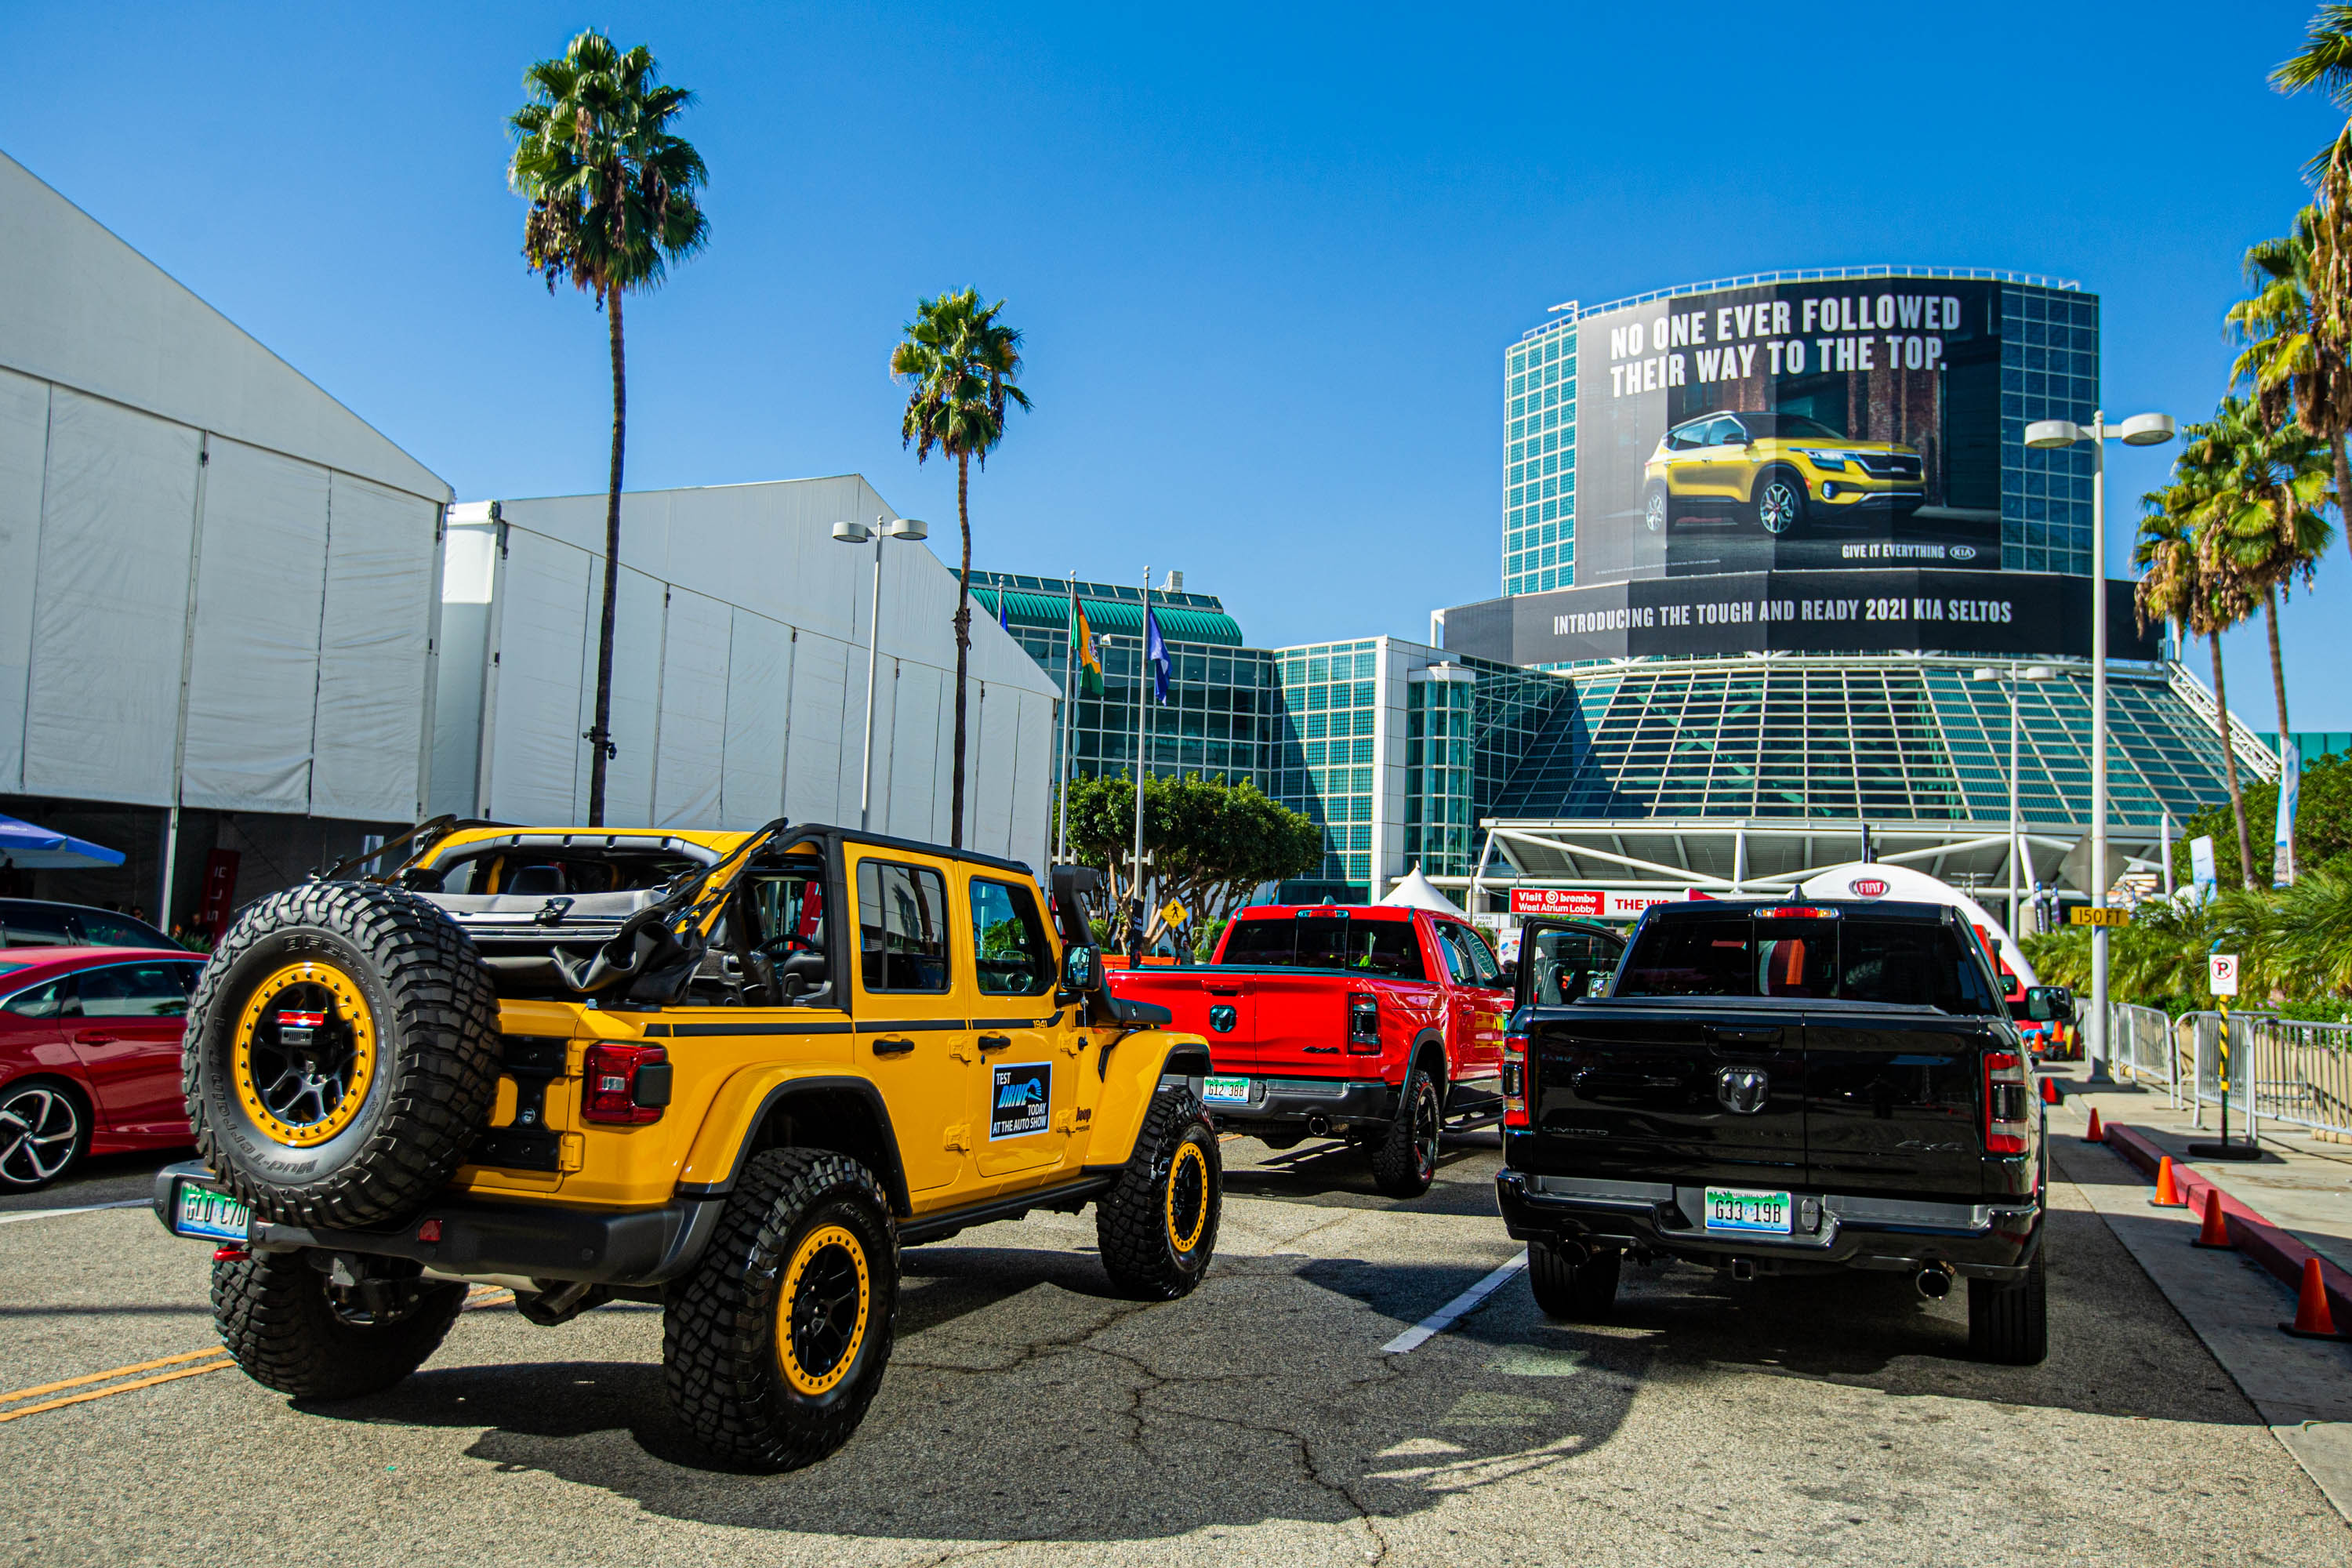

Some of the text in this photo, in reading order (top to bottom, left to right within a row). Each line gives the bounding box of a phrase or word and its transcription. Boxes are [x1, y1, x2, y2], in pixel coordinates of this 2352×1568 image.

[1610, 294, 1961, 361] NO ONE EVER FOLLOWED
[1610, 335, 1947, 398] THEIR WAY TO THE TOP.
[1842, 543, 1945, 558] GIVE IT EVERYTHING
[1952, 546, 1973, 558] KIA
[1553, 598, 2012, 635] INTRODUCING THE TOUGH AND READY 2021 KIA SELTOS
[1858, 881, 1882, 895] FIAT
[1519, 892, 1596, 903] Visit brembo
[1614, 898, 1644, 910] THE
[1519, 902, 1596, 915] West Atrium Lobby
[2079, 909, 2122, 924] 150 FT
[1033, 1019, 1048, 1029] 1941
[996, 1072, 1011, 1085] TEST
[997, 1083, 1029, 1109] DRIVE
[1028, 1102, 1047, 1116] TODAY
[1076, 1106, 1091, 1123] Jeep
[993, 1115, 1047, 1134] AT THE AUTO SHOW
